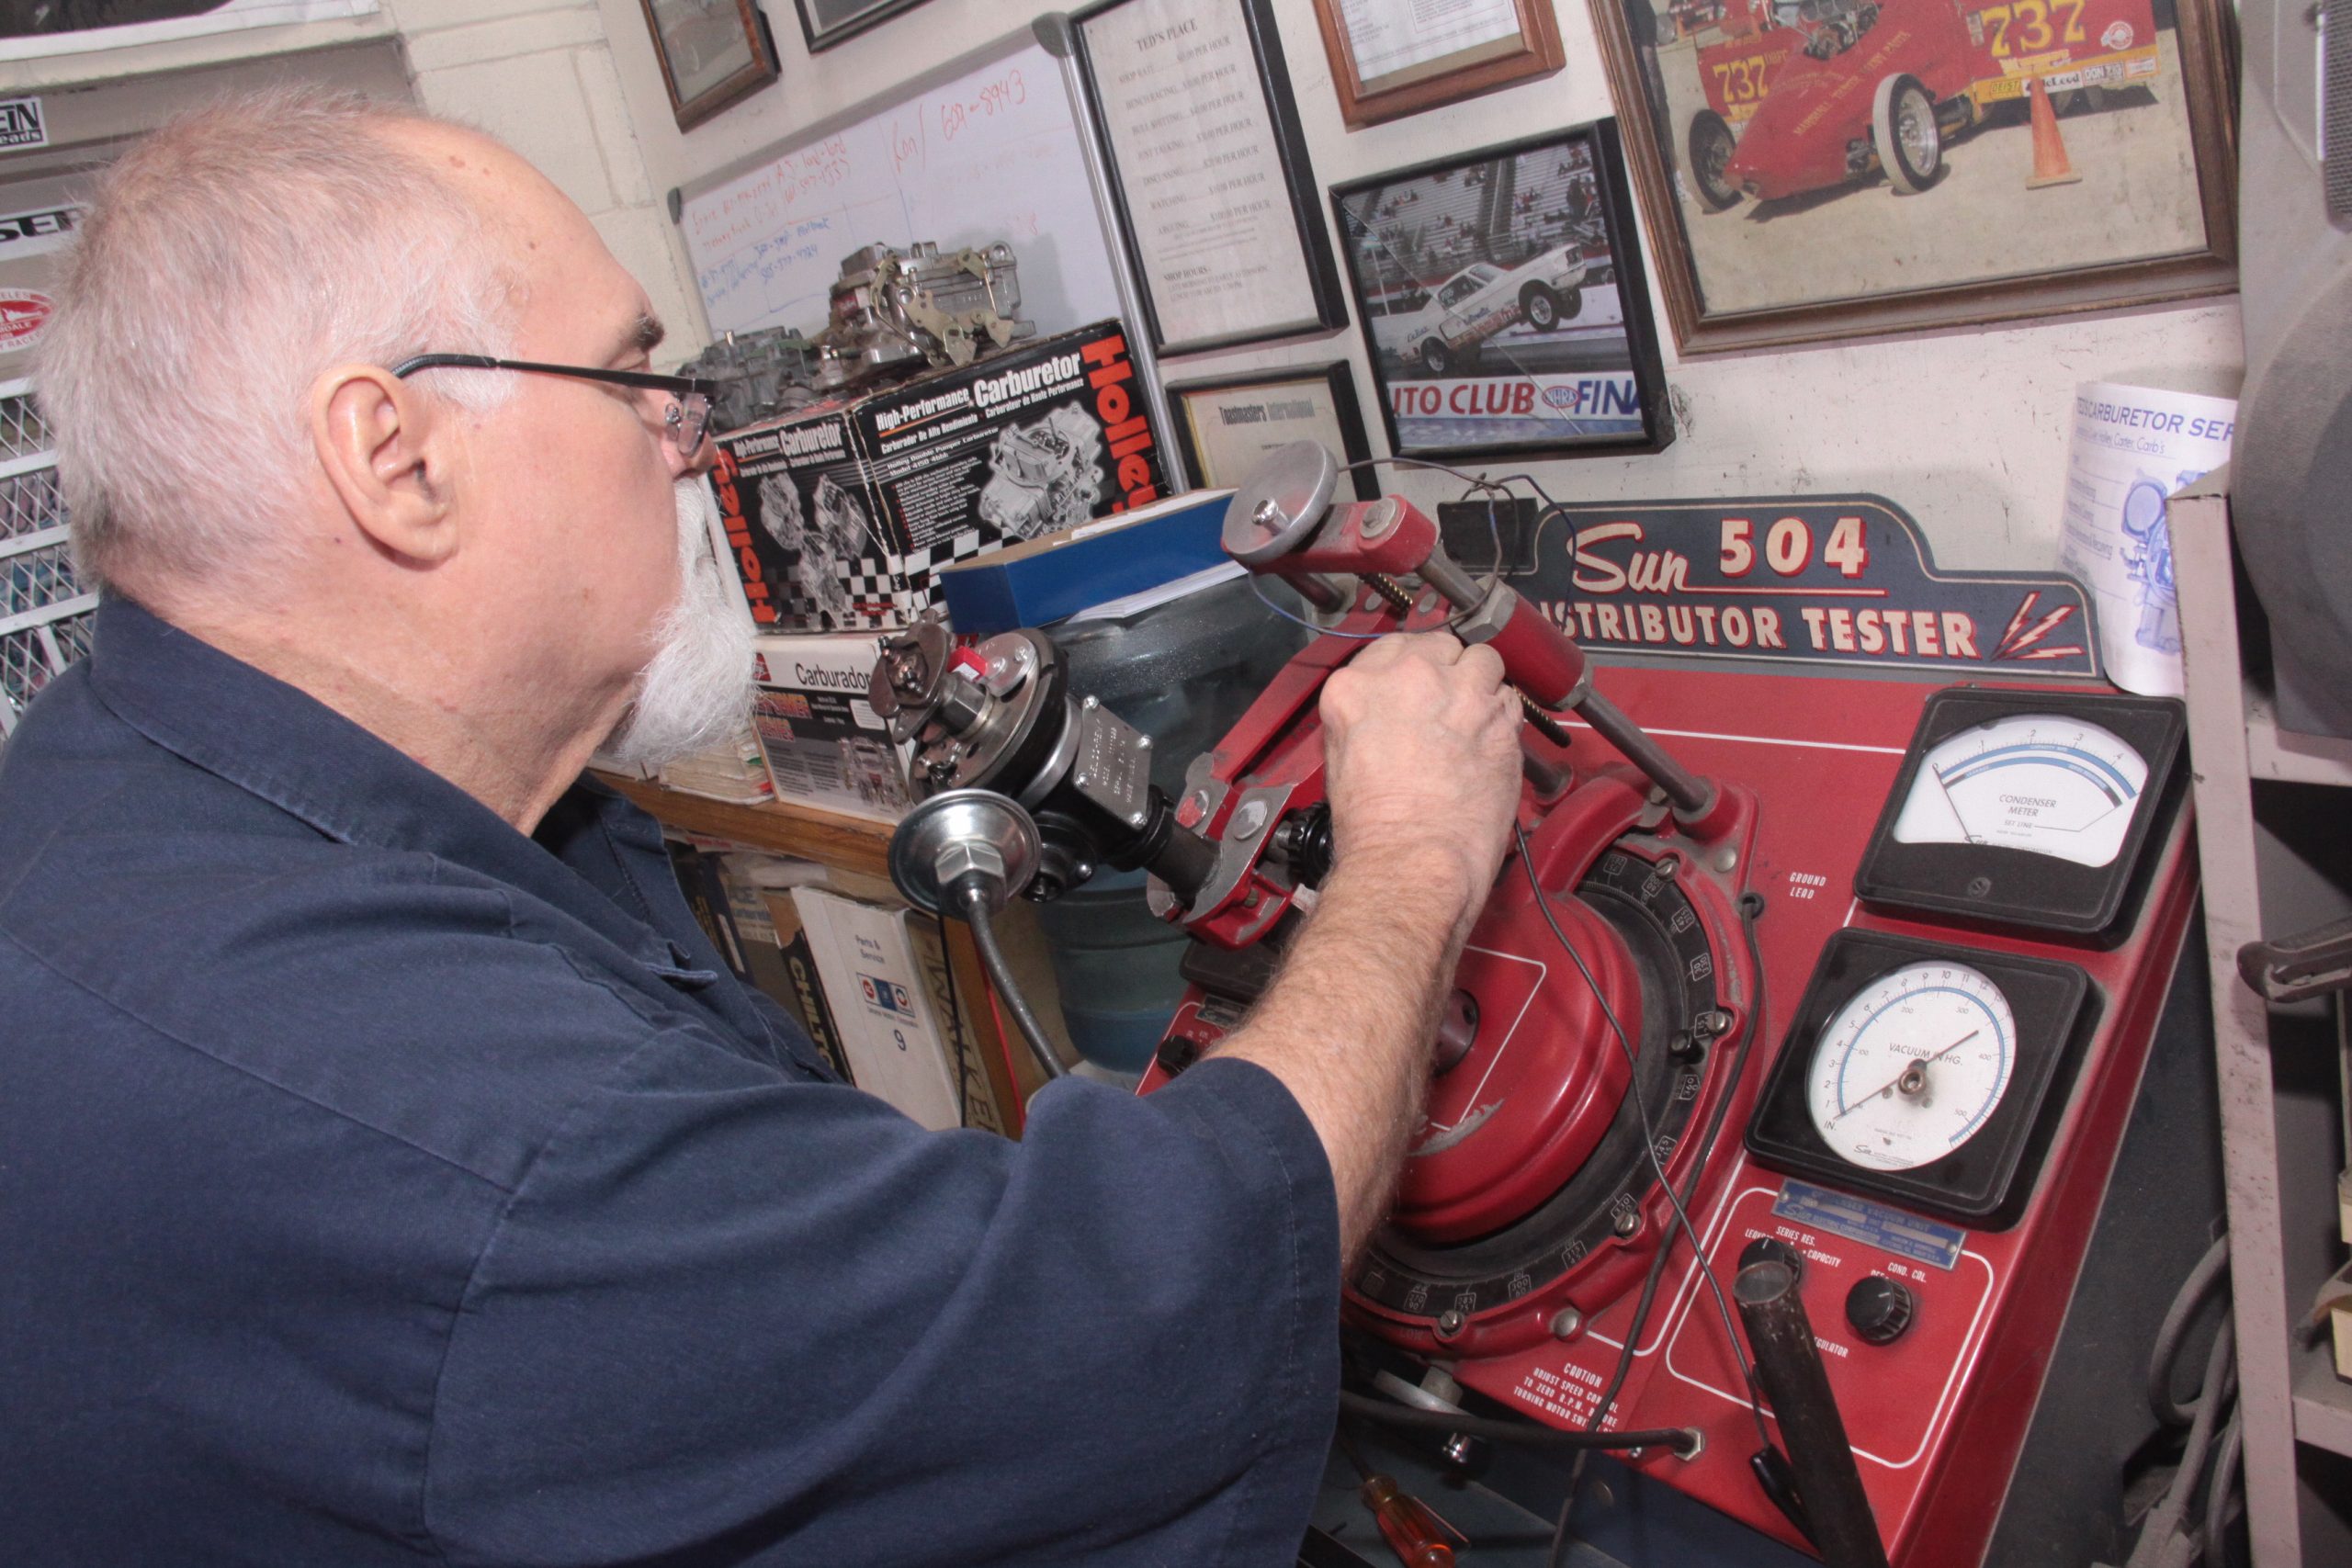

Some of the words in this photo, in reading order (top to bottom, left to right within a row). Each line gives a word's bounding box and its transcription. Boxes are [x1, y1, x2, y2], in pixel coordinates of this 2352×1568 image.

[1136, 30, 1166, 52] TED'S
[1167, 17, 1198, 40] PLACE
[1980, 0, 2086, 57] 737
[1713, 54, 1769, 104] 737
[1230, 118, 1252, 133] HOUR
[1237, 144, 1260, 161] HOUR
[1244, 172, 1266, 186] HOUR
[1249, 198, 1272, 214] HOUR
[875, 388, 971, 432] High-Performance
[973, 353, 1081, 409] Carburetor
[1449, 382, 1536, 415] CLUB
[1547, 389, 1579, 407] NHRA
[881, 434, 918, 455] Carburador
[928, 425, 941, 438] Alto
[1048, 378, 1084, 398] Performance
[1218, 403, 1268, 426] Toastmasters
[2088, 401, 2183, 434] CARBURETOR
[780, 422, 843, 457] Carburetor
[888, 457, 910, 470] Holley
[935, 440, 961, 456] Pumper
[889, 464, 911, 478] Model
[1565, 520, 1689, 596] Sun
[1719, 515, 1871, 579] 504
[1539, 601, 1788, 650] ISTRIBUTOR
[1801, 606, 1983, 660] TESTER
[795, 661, 871, 690] Carburador
[1998, 794, 2057, 808] CONDENSER
[2007, 806, 2040, 818] METER
[2004, 819, 2016, 828] SET
[2017, 820, 2033, 829] LINE
[1789, 871, 1826, 888] GROUND
[1790, 886, 1815, 900] LEAD
[855, 934, 873, 950] Parts
[860, 949, 886, 964] Service
[1901, 978, 1907, 987] 8
[1922, 972, 1928, 980] 9
[1942, 970, 1951, 979] 10
[1962, 973, 1970, 982] 11
[1882, 990, 1889, 998] 7
[1901, 1007, 1914, 1015] 200
[1849, 1021, 1856, 1029] 5
[893, 1029, 907, 1052] 9
[1858, 1048, 1869, 1056] 100
[1889, 1042, 1930, 1057] VACUUM
[1945, 1055, 1963, 1066] HG.
[1978, 1053, 1992, 1061] 400
[1828, 1059, 1836, 1068] 3
[1824, 1080, 1831, 1089] 2
[1824, 1120, 1837, 1131] IN.
[1775, 1226, 1798, 1240] SERIES
[1801, 1234, 1815, 1247] RES.
[1807, 1249, 1842, 1268] CAPACITY
[1887, 1262, 1908, 1277] COND.
[1912, 1269, 1927, 1283] CAL.
[1563, 1362, 1603, 1389] CAUTION
[1532, 1367, 1560, 1386] ADJUST
[1560, 1380, 1584, 1397] SPEED
[1586, 1392, 1618, 1414] CONOL
[1513, 1386, 1544, 1407] TURNING
[1545, 1401, 1571, 1420] MOTOR
[1523, 1376, 1533, 1388] TO
[1536, 1382, 1555, 1398] ZERO
[1559, 1393, 1584, 1413] R.P.M.
[1588, 1407, 1618, 1427] BORE
